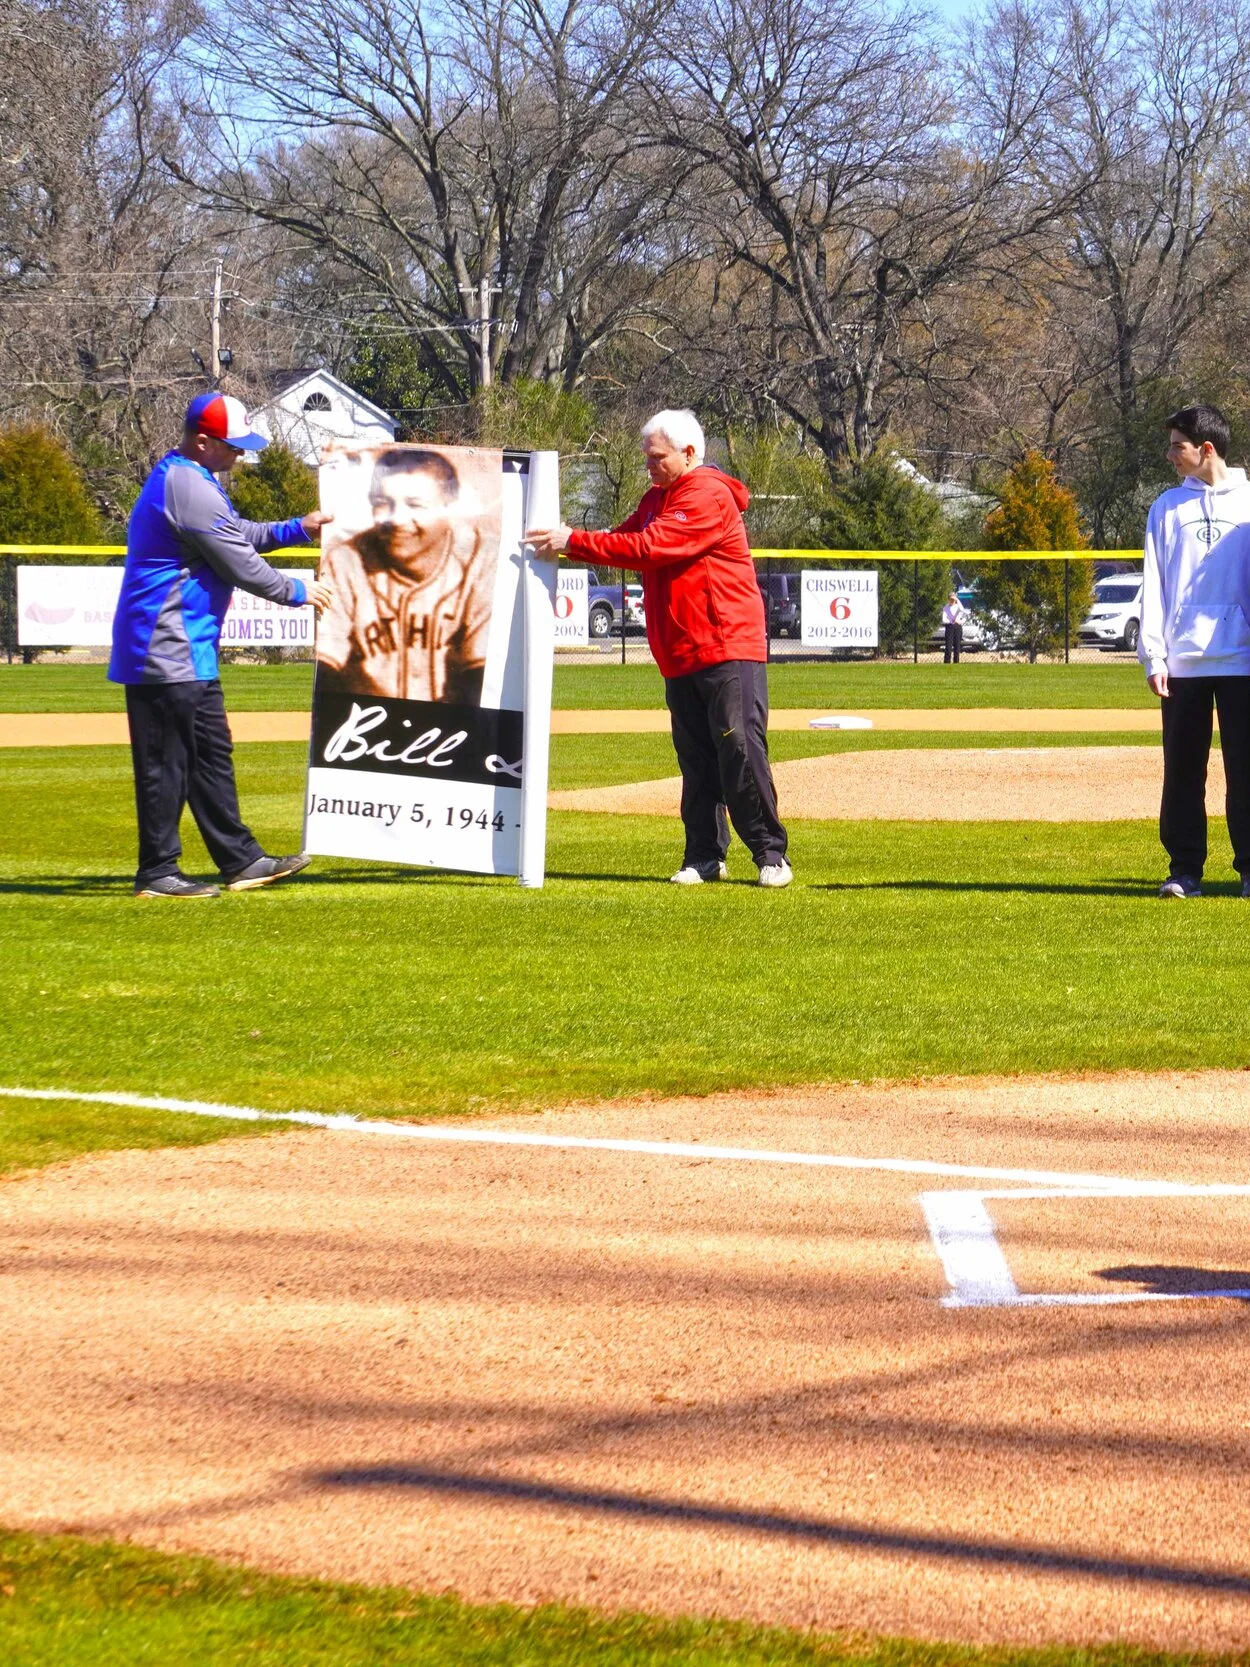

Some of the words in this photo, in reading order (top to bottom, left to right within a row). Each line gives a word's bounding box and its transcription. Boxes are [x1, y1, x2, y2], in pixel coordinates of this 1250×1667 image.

[806, 579, 874, 592] CRISWELL
[829, 596, 851, 621] 6
[280, 618, 309, 640] YOU
[553, 624, 584, 637] 2002
[807, 625, 873, 638] 2012-2016
[323, 702, 468, 767] Bill
[308, 794, 402, 827] January
[410, 803, 433, 829] 5,
[445, 806, 505, 832] 1944
